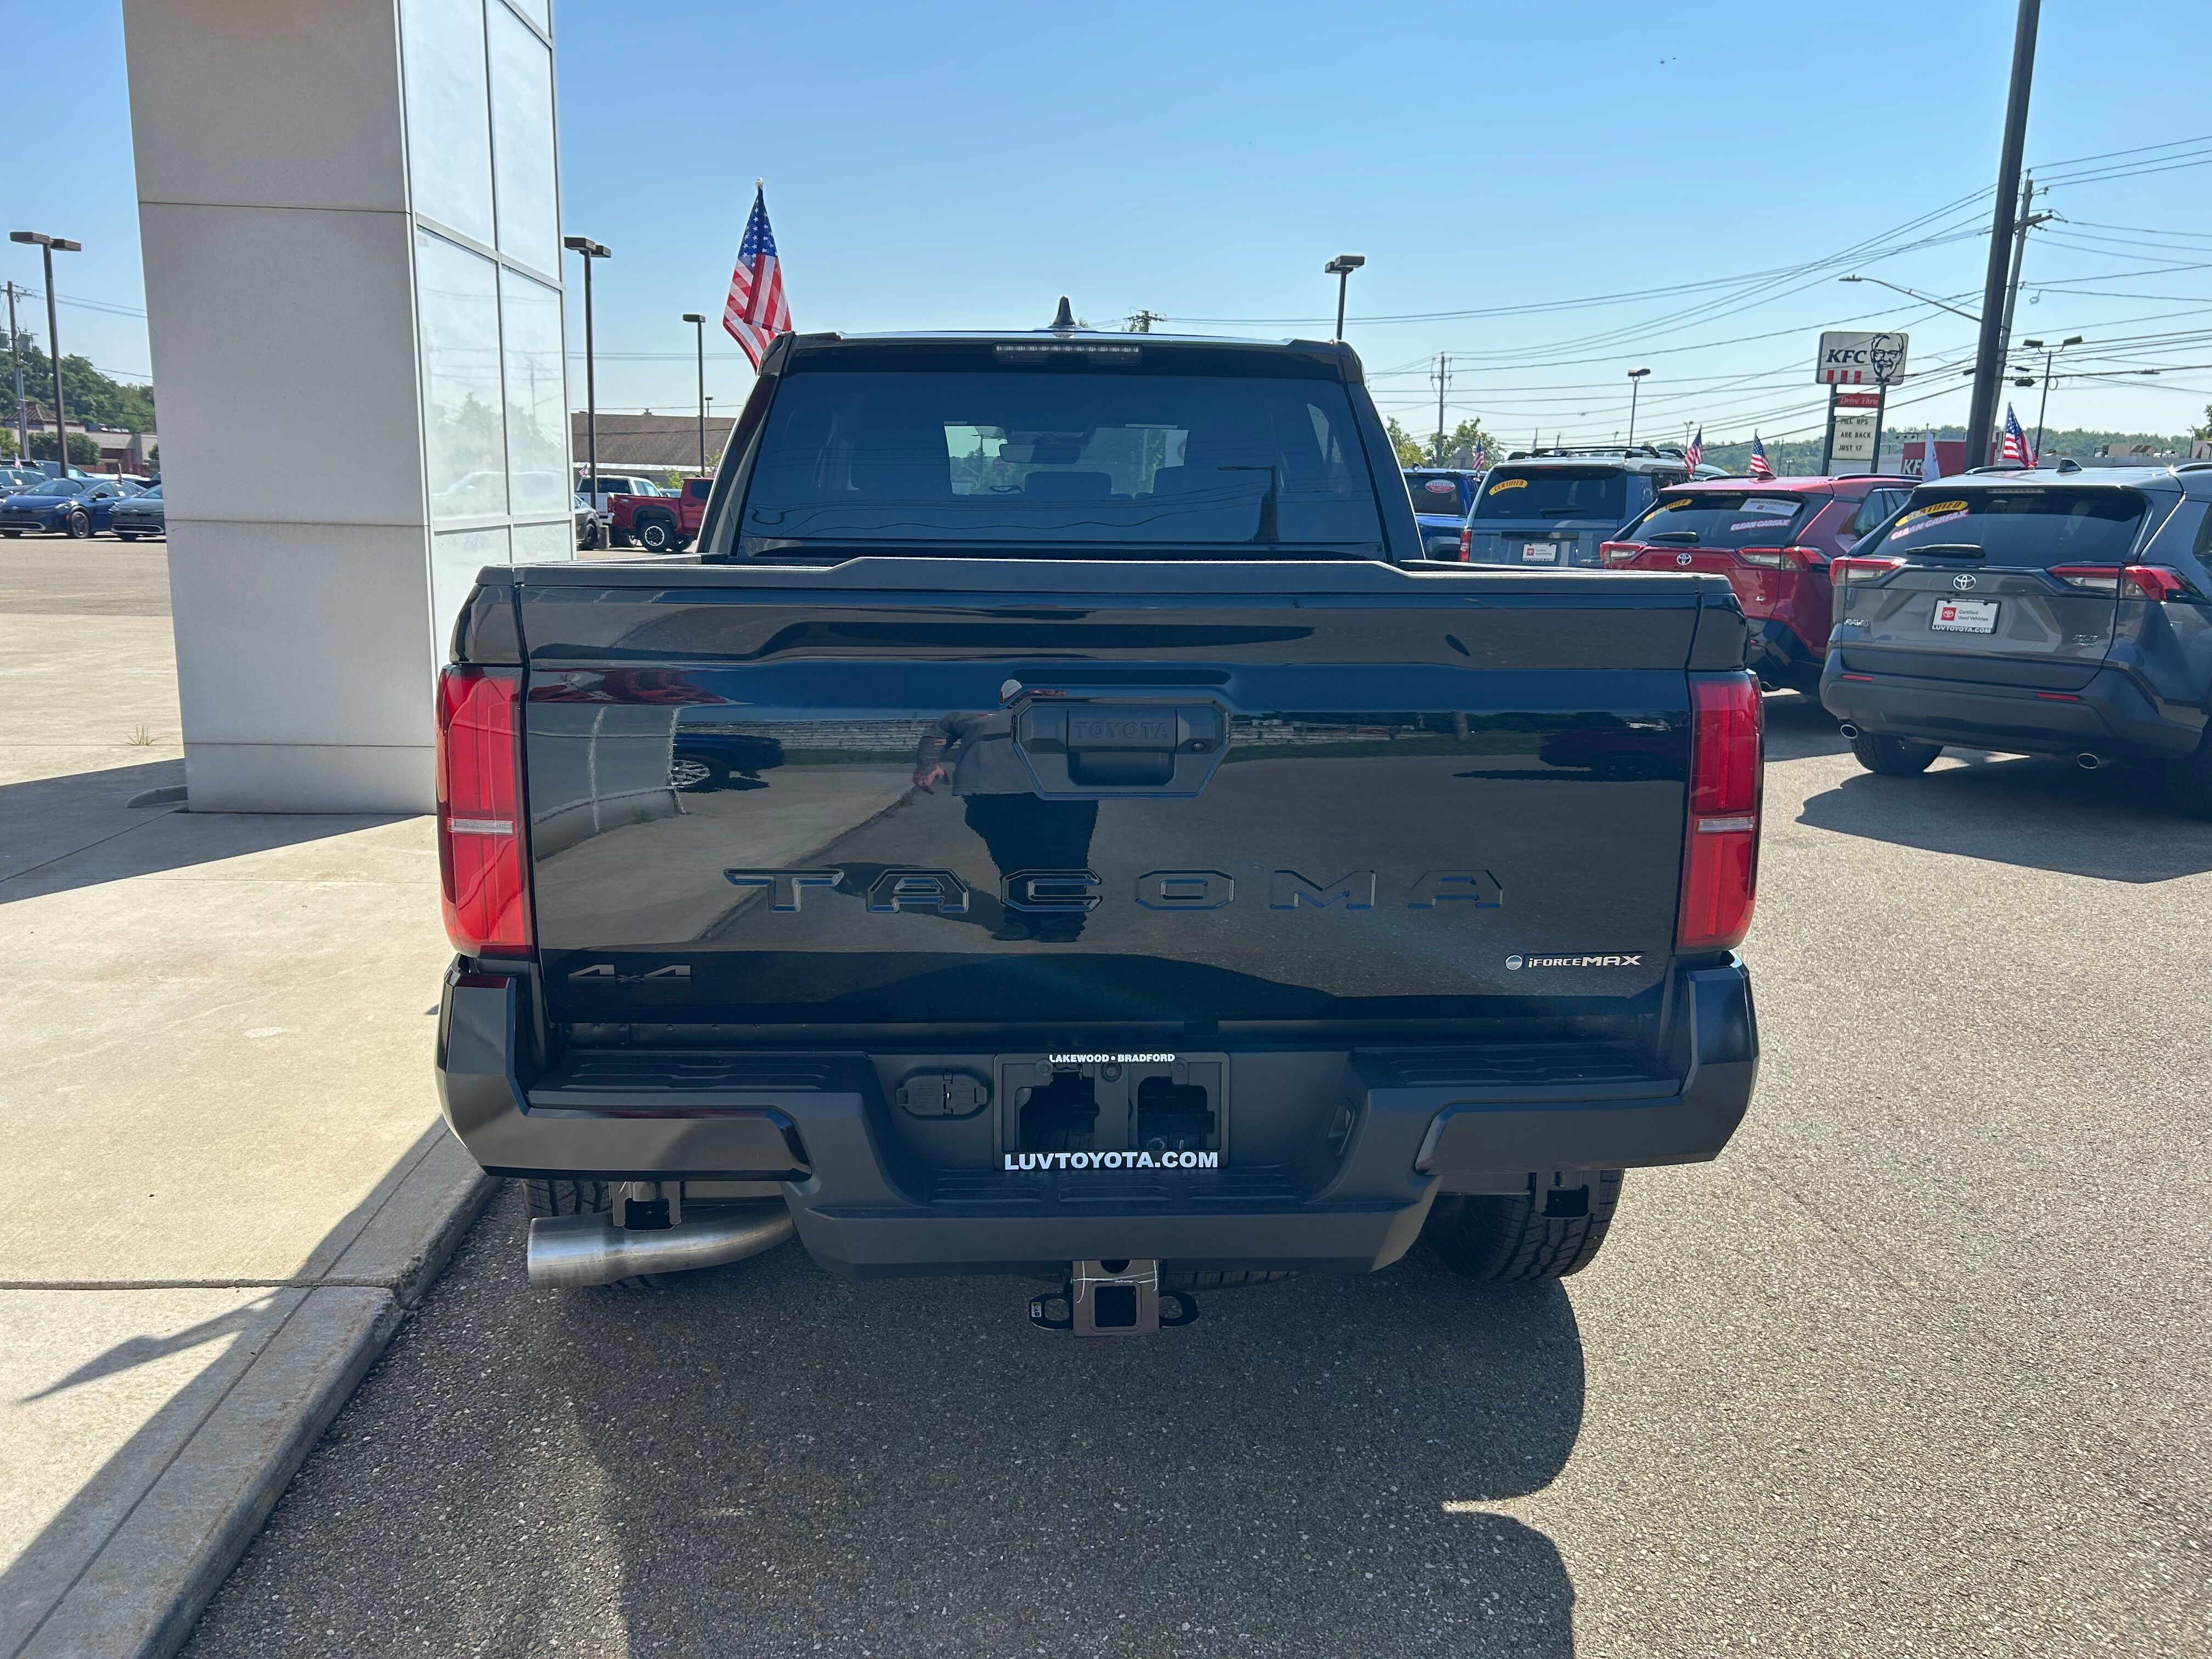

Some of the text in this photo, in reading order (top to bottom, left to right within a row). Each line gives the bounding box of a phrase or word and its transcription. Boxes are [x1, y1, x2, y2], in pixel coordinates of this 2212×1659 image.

[1826, 349, 1867, 363] KFC
[1494, 479, 1524, 492] CERTIFIED
[1932, 625, 1991, 634] LUVTOYOTA.COM
[1074, 721, 1170, 738] TOYOTA
[723, 868, 1503, 913] TACOMA
[1048, 1053, 1175, 1063] LAKEWOOD BRADFORD
[1005, 1151, 1218, 1170] LUVTOYOTA.COM
